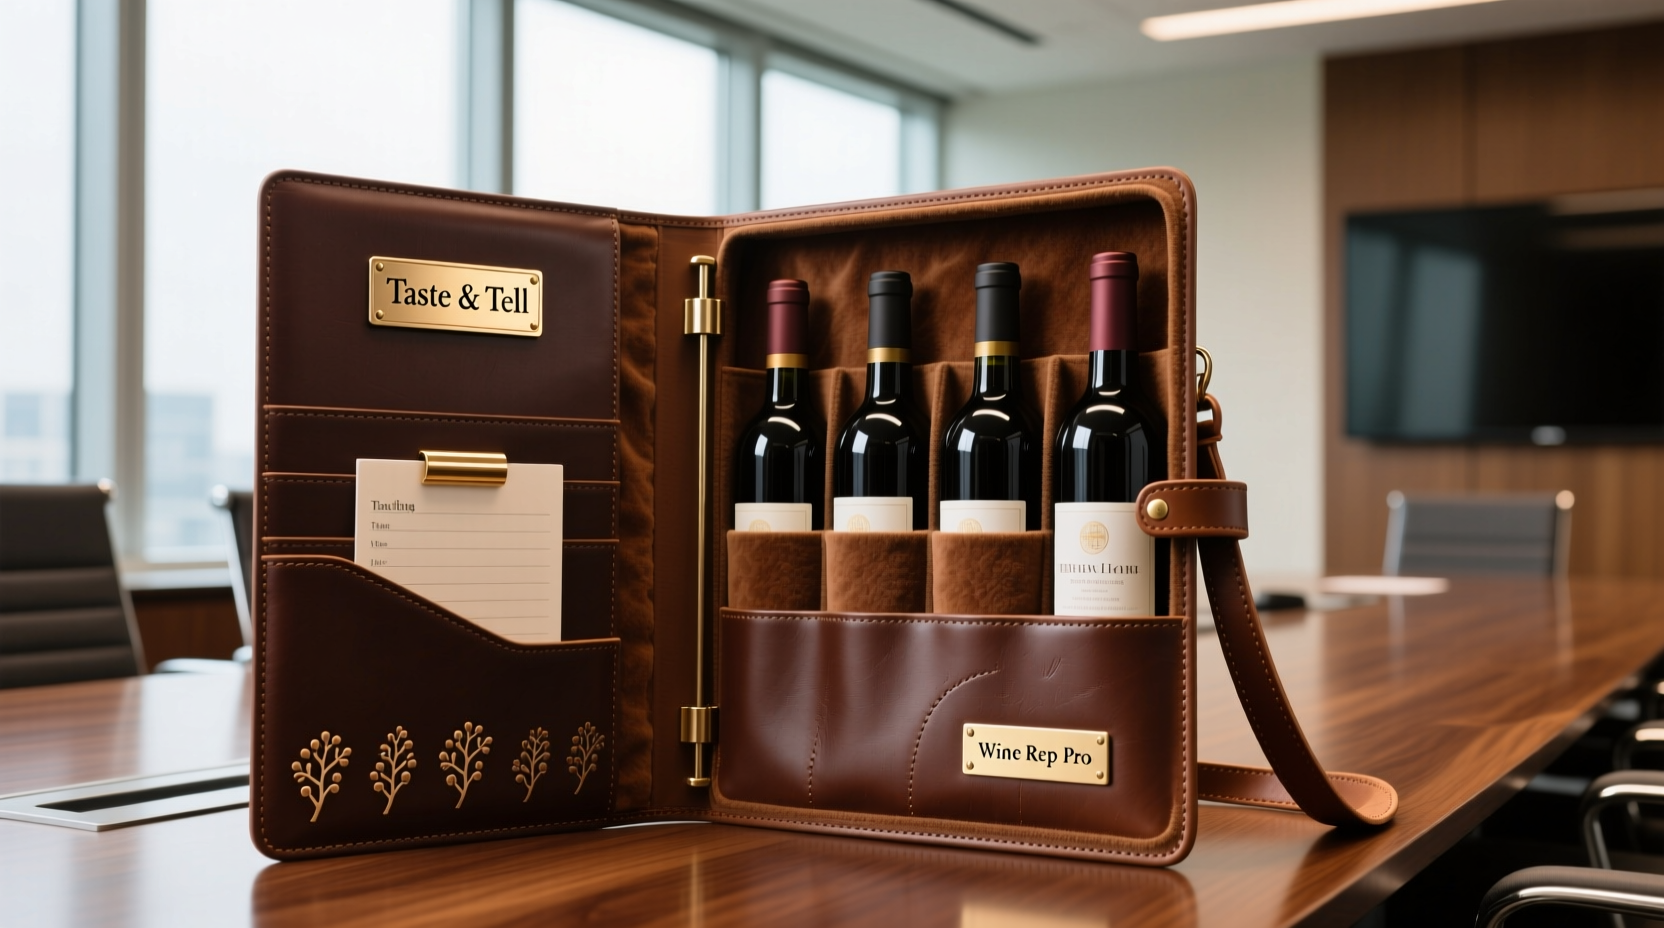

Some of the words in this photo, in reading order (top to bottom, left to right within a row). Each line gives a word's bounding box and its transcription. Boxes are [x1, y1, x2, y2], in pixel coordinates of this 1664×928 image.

[386, 277, 451, 307] Taste
[458, 283, 480, 310] &
[485, 286, 529, 313] Tell
[979, 742, 1021, 760] Wine
[1026, 745, 1057, 767] Rep
[1064, 747, 1092, 765] Pro
